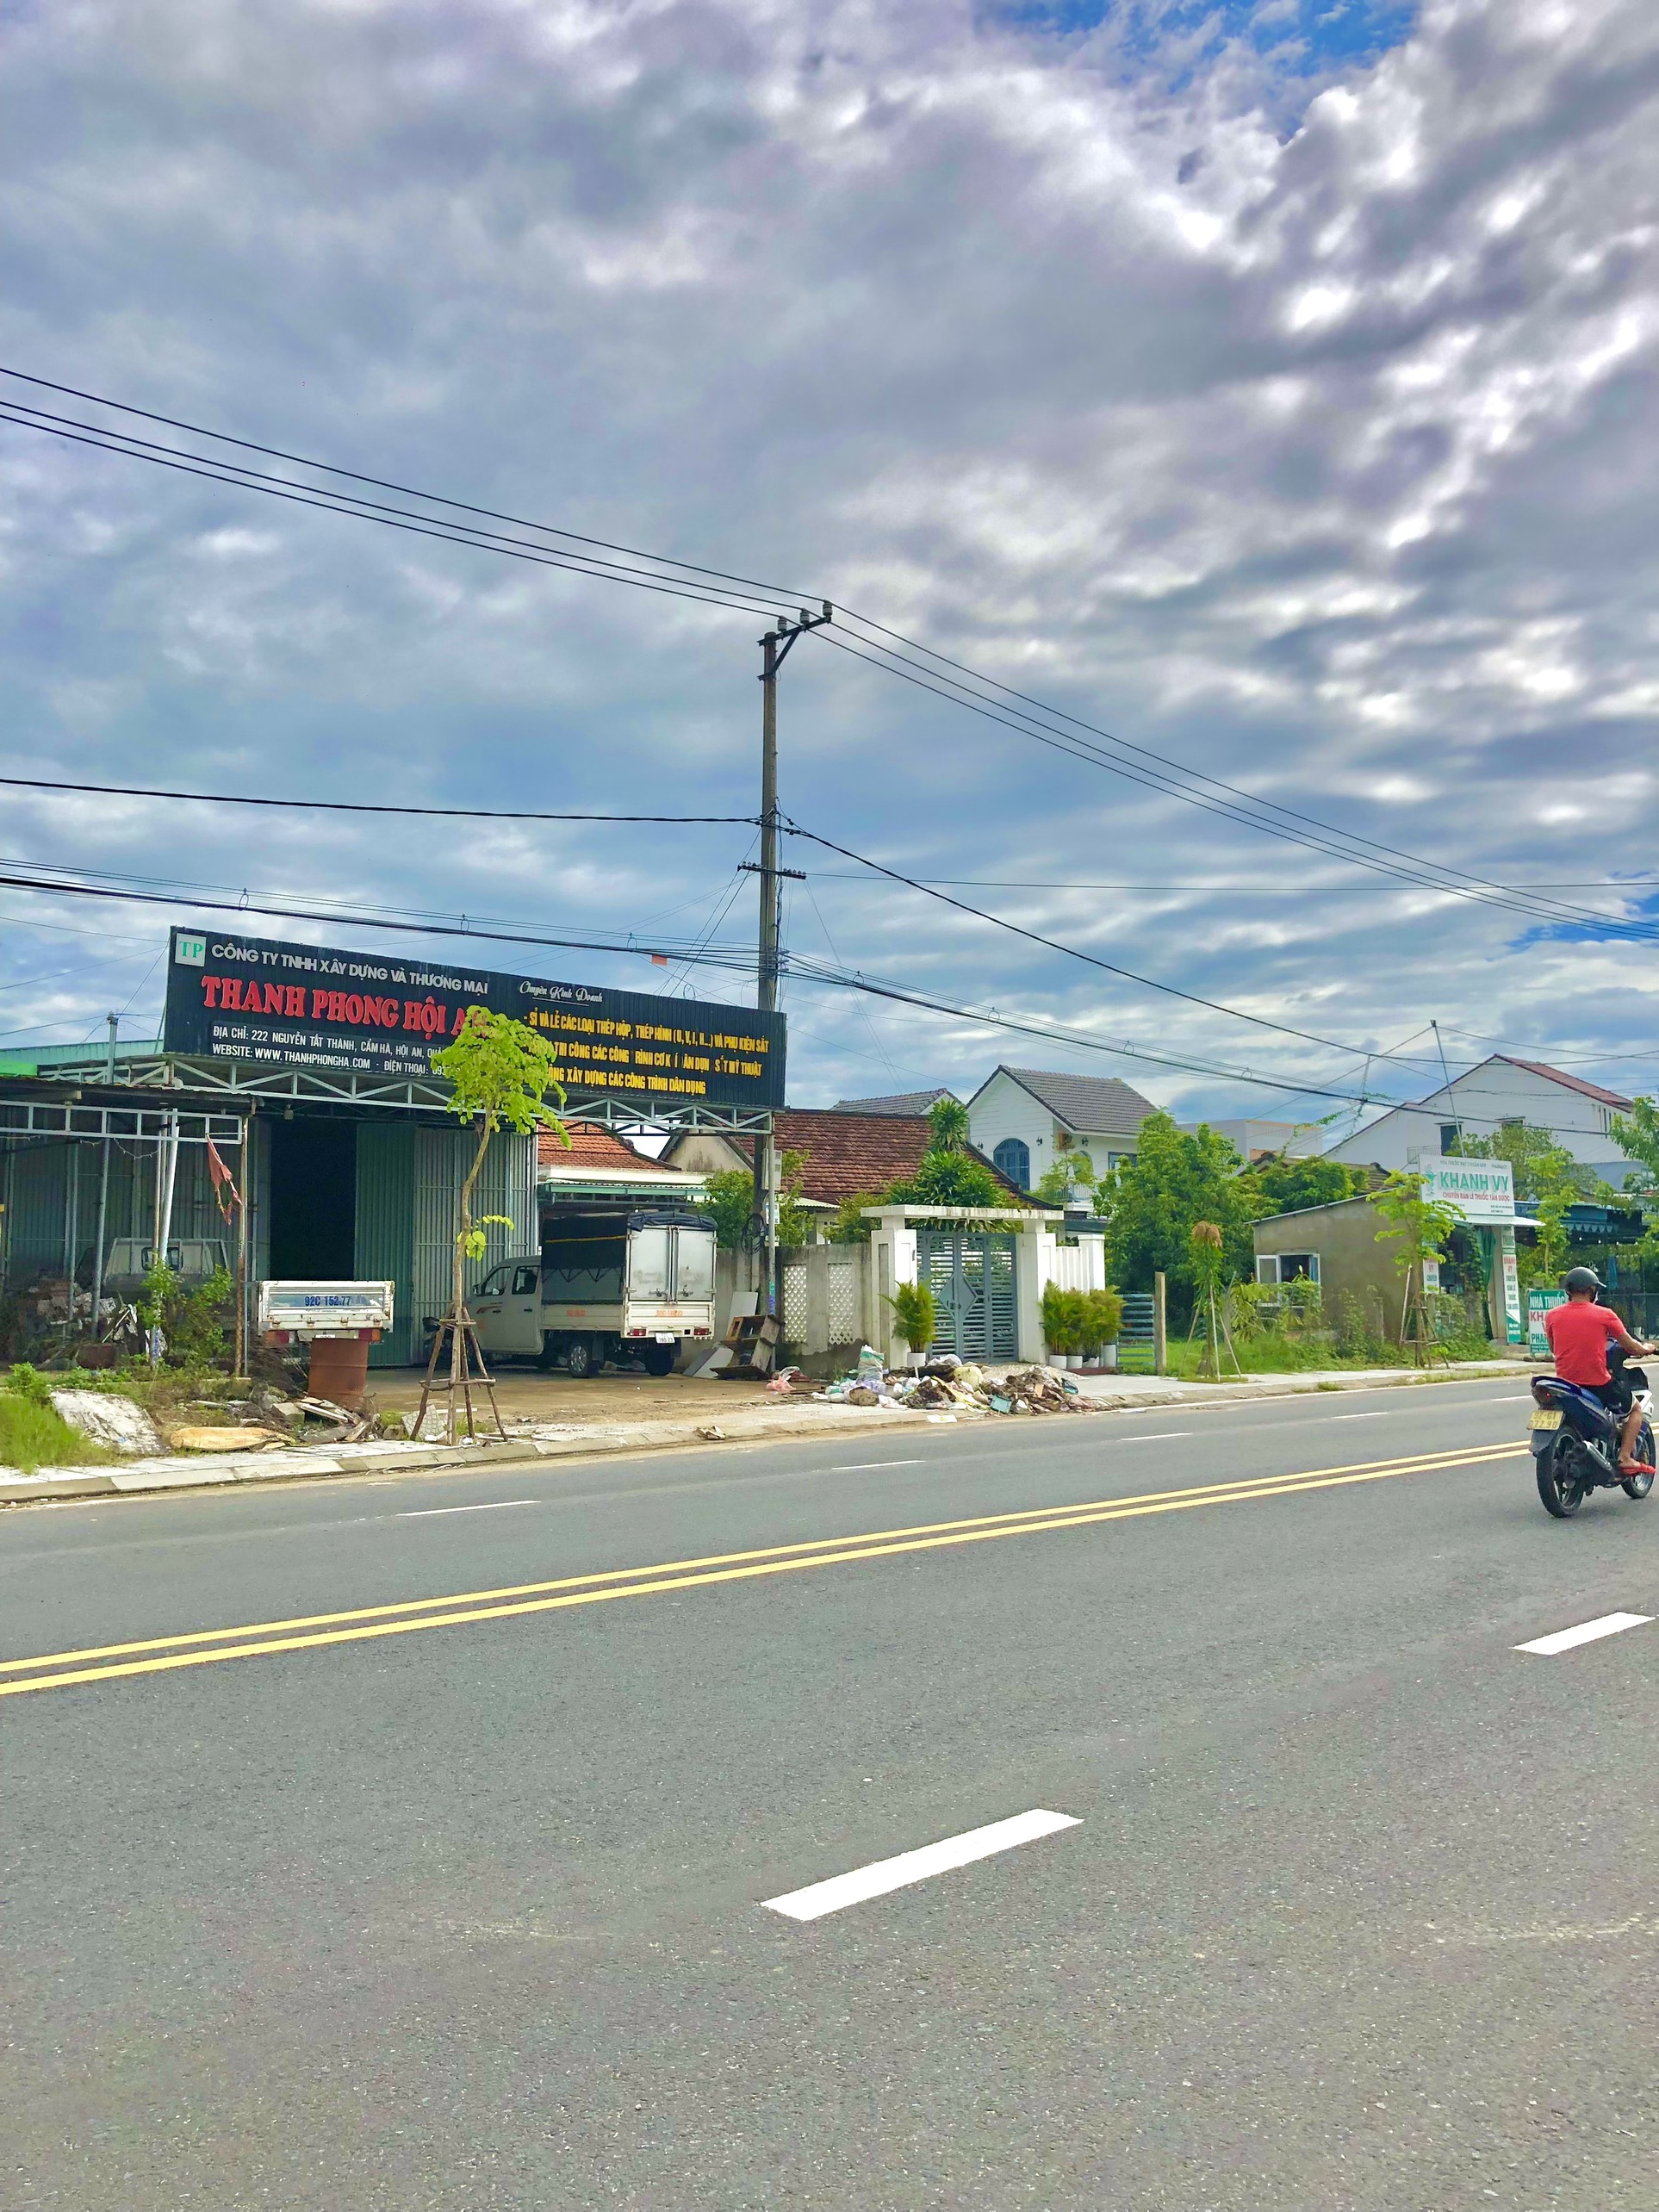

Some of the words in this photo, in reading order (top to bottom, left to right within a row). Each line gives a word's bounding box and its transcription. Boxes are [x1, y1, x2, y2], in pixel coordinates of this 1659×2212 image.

[179, 941, 203, 958] TP
[211, 942, 259, 963] CÔNG
[261, 951, 279, 966] TY
[281, 954, 317, 972] TNHH
[320, 958, 347, 975] XÂY
[349, 964, 388, 980] DỰNG
[391, 967, 407, 984] VÀ
[409, 972, 462, 991] THƯƠNG
[464, 979, 488, 996] MẠI
[202, 975, 307, 1017] THANH
[311, 989, 399, 1028] PHONG
[402, 996, 446, 1040] HỘI
[519, 980, 547, 996] Chuyên
[550, 986, 573, 999] Kinh
[575, 988, 603, 1003] Doanh
[213, 1025, 228, 1039] ĐỊA
[231, 1025, 249, 1040] CHỈ:
[252, 1029, 269, 1042] 222
[272, 1031, 307, 1046] NGUYỄN
[326, 1035, 357, 1052] THÀNH,
[360, 1038, 378, 1053] CẨM
[380, 1042, 393, 1056] HÀ,
[395, 1044, 408, 1058] HỘI
[411, 1047, 425, 1059] AN,
[529, 1007, 538, 1026] SỈ
[539, 1010, 550, 1028] VÀ
[550, 1010, 560, 1029] LẺ
[560, 1014, 577, 1031] CÁC
[578, 1017, 595, 1035] LOẠI
[596, 1018, 615, 1035] THÉP
[635, 1022, 654, 1040] THÉP
[655, 1024, 672, 1043] HÌNH
[714, 1033, 724, 1048] VÀ
[724, 1035, 738, 1053] PHỤ
[739, 1035, 755, 1053] KIỆN
[755, 1035, 769, 1053] SẮT
[212, 1043, 253, 1058] WEBSITE:
[404, 1062, 429, 1077] THOẠI:
[554, 1041, 568, 1056] THI
[569, 1041, 591, 1059] CÔNG
[592, 1044, 607, 1060] CÁC
[609, 1046, 630, 1063] CÔNG
[741, 1060, 762, 1078] THUẬT
[567, 1066, 583, 1084] XÂY
[585, 1070, 607, 1087] DỰNG
[608, 1071, 624, 1087] CÁC
[624, 1072, 645, 1089] CÔNG
[647, 1074, 668, 1091] TRÌNH
[669, 1076, 685, 1093] DÂN
[686, 1079, 706, 1096] DỤNG
[1439, 1171, 1488, 1190] KHANH
[1491, 1175, 1509, 1191] VY
[305, 1296, 320, 1306] 92C
[324, 1296, 351, 1306] 152.77
